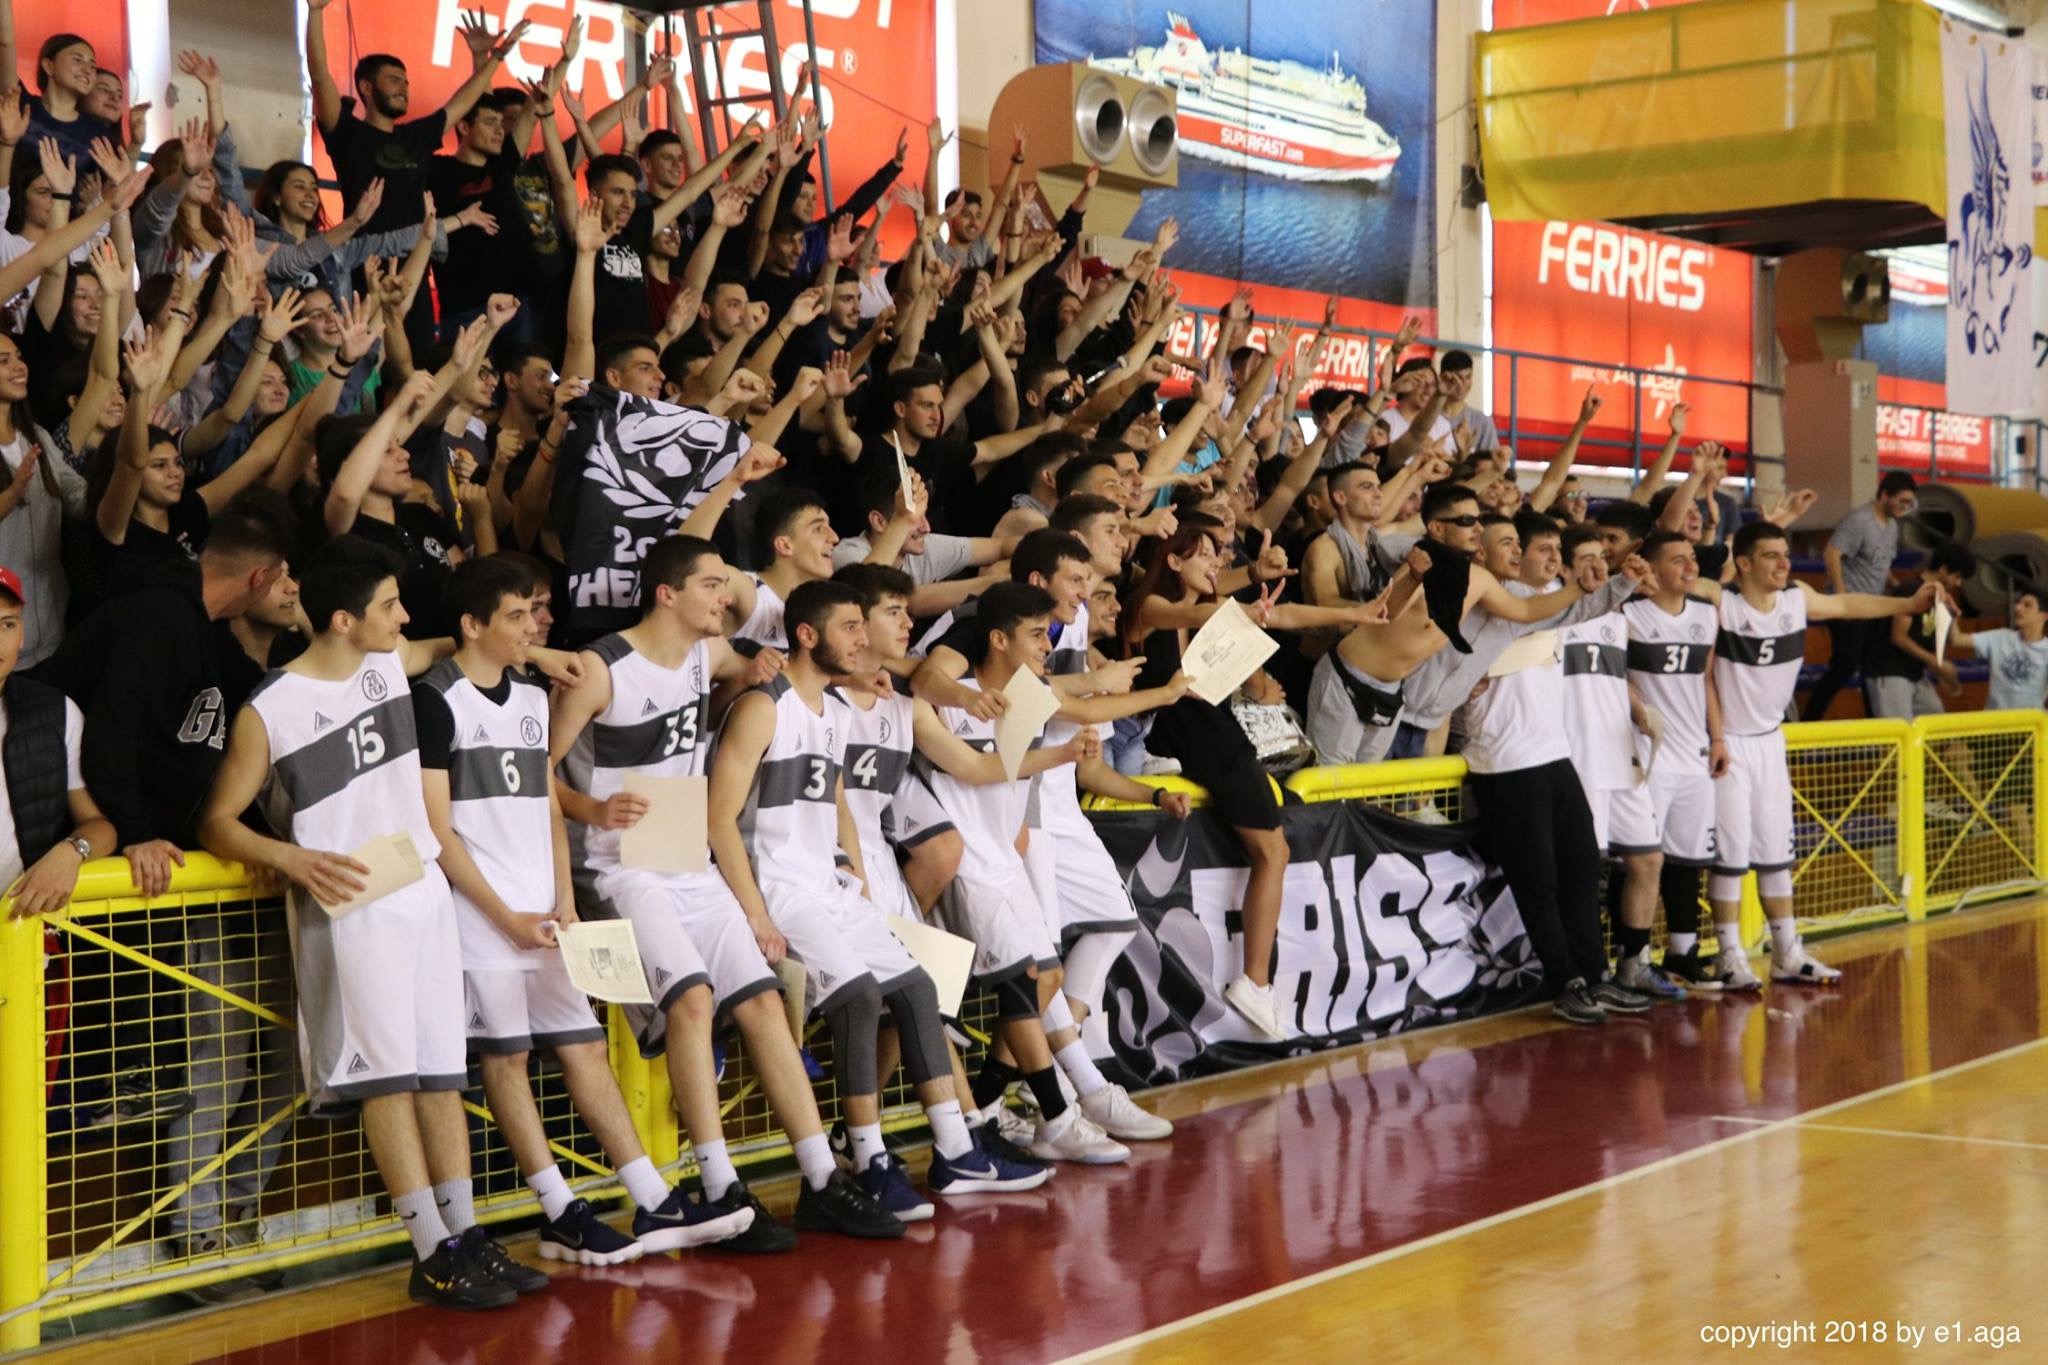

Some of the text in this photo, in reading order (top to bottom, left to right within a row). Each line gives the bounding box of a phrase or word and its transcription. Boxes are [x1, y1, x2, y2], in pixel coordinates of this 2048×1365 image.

[1538, 220, 1706, 312] FERRIES
[1922, 411, 1982, 446] FERRIES
[1587, 645, 1600, 672] 7
[1663, 645, 1690, 672] 31
[1757, 639, 1775, 665] 5
[347, 715, 386, 770] 15
[663, 706, 698, 756] 33
[501, 750, 520, 793] 6
[804, 759, 827, 799] 3
[852, 748, 878, 786] 4
